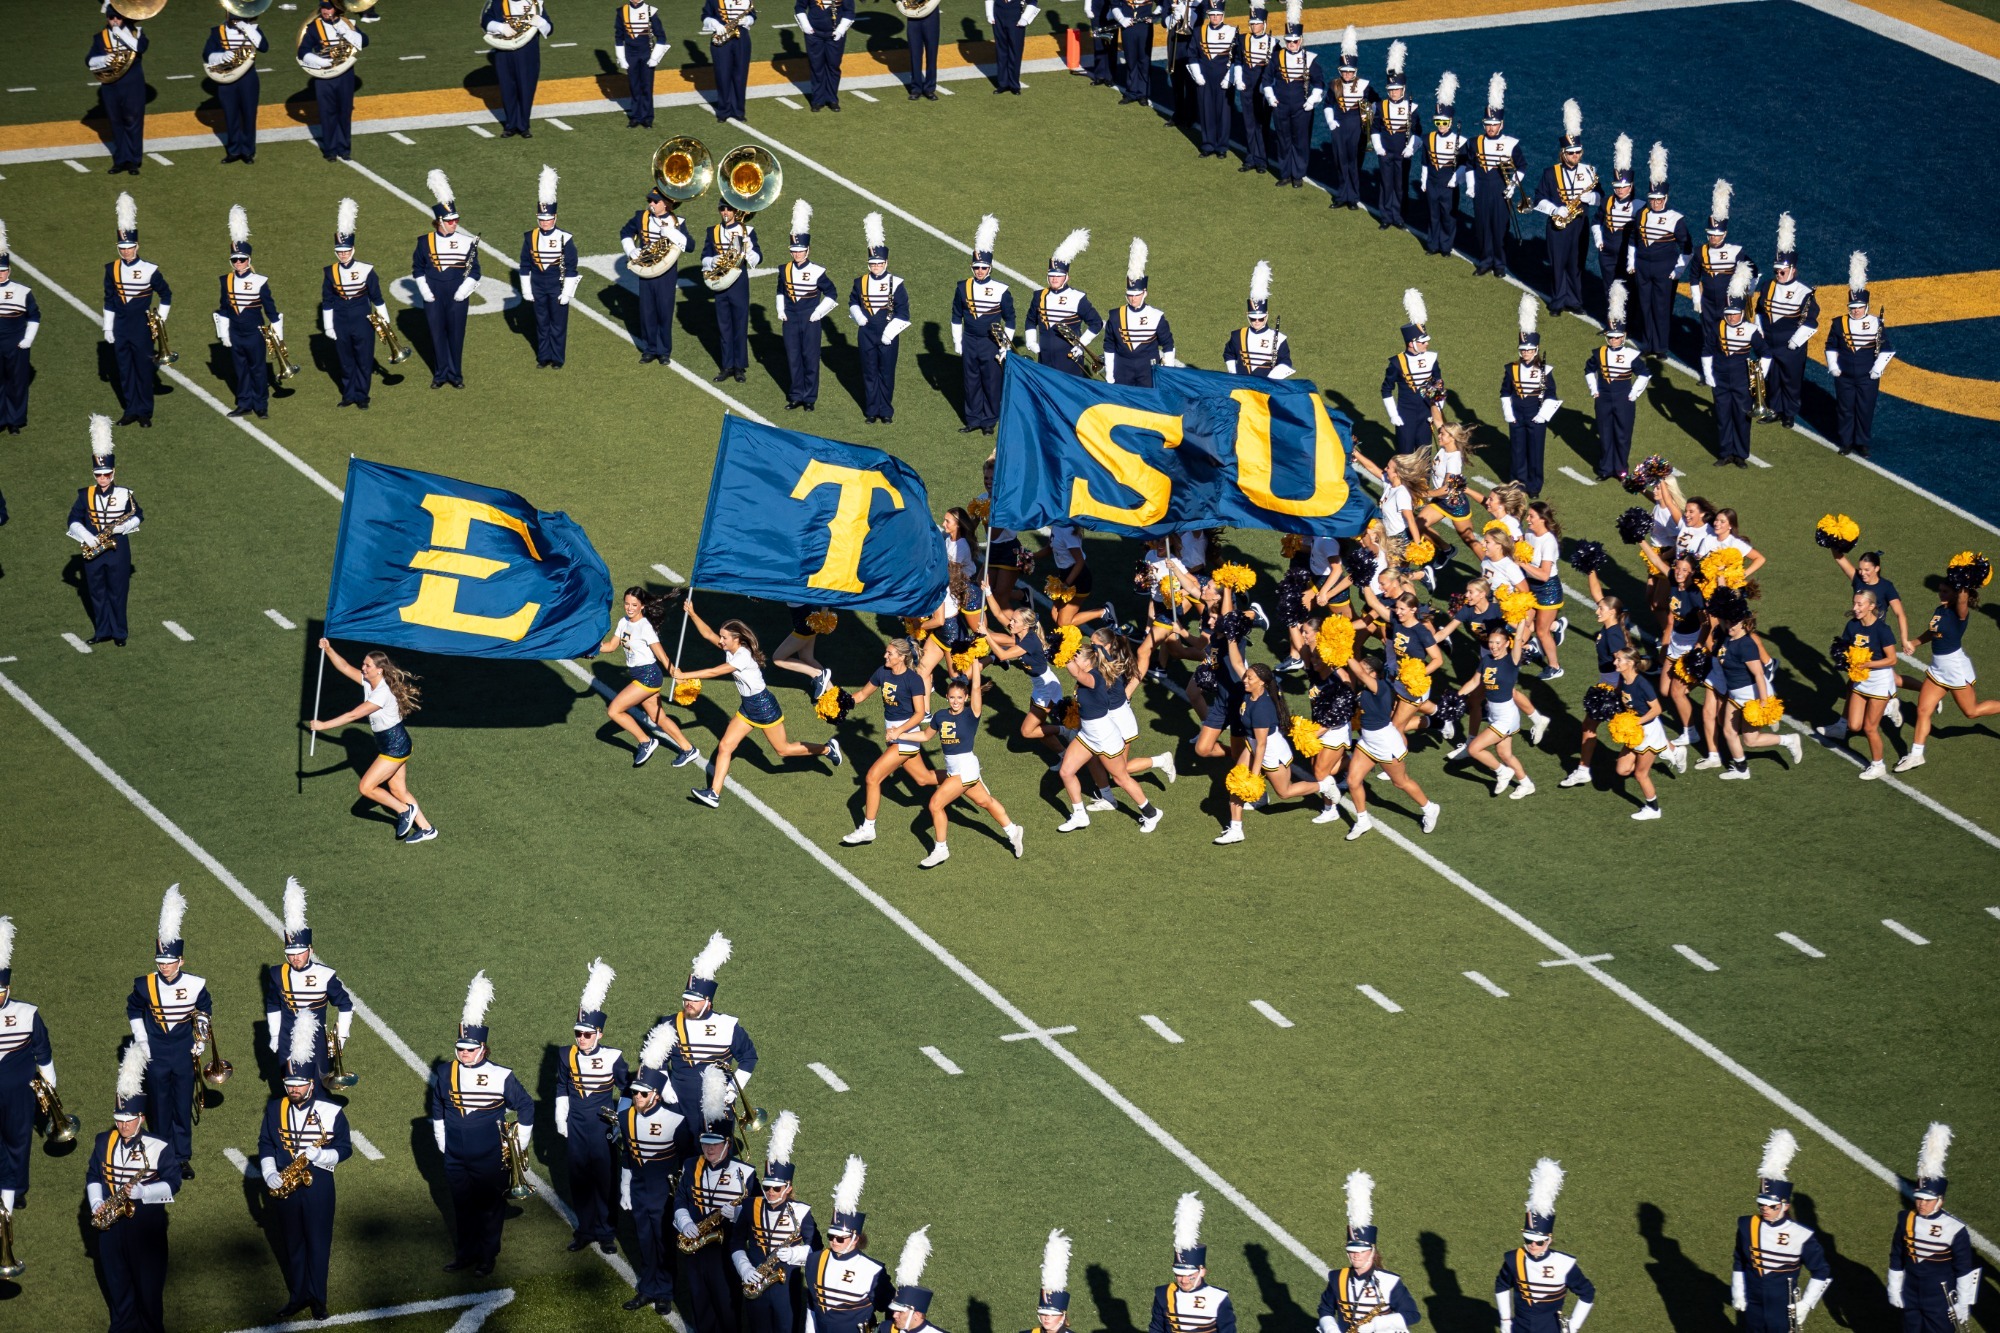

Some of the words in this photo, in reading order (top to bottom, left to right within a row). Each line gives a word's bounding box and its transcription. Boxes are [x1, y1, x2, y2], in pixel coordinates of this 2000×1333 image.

[1259, 42, 1266, 50] E
[1576, 173, 1584, 181] E
[449, 241, 458, 249] E
[549, 239, 557, 248] E
[1720, 252, 1728, 260] E
[133, 271, 141, 279] E
[350, 272, 358, 280] E
[802, 273, 810, 281] E
[244, 282, 252, 290] E
[985, 288, 993, 296] E
[1785, 291, 1794, 299] E
[1059, 296, 1067, 305] E
[1140, 317, 1148, 325] E
[1862, 322, 1870, 330] E
[1736, 327, 1744, 336] E
[1260, 339, 1269, 348] E
[1418, 359, 1426, 368] E
[1616, 355, 1624, 363] E
[1530, 370, 1538, 378] E
[1233, 390, 1350, 516] U
[1069, 403, 1184, 527] S
[108, 496, 116, 506] E
[790, 459, 904, 593] T
[1677, 532, 1693, 548] E
[398, 494, 542, 641] E
[1394, 632, 1410, 652] E
[1482, 667, 1498, 685] E
[882, 681, 898, 702] E
[940, 721, 957, 739] E
[305, 975, 316, 987] E
[176, 988, 187, 1000] E
[5, 1015, 16, 1027] E
[705, 1025, 716, 1036] E
[591, 1058, 603, 1069] E
[476, 1074, 488, 1086] E
[649, 1123, 662, 1136] E
[131, 1150, 142, 1161] E
[719, 1173, 731, 1186] E
[778, 1214, 790, 1227] E
[1929, 1225, 1941, 1237] E
[1777, 1233, 1789, 1246] E
[842, 1270, 855, 1283] E
[1542, 1266, 1554, 1278] E
[1364, 1286, 1376, 1298] E
[1194, 1296, 1206, 1309] E
